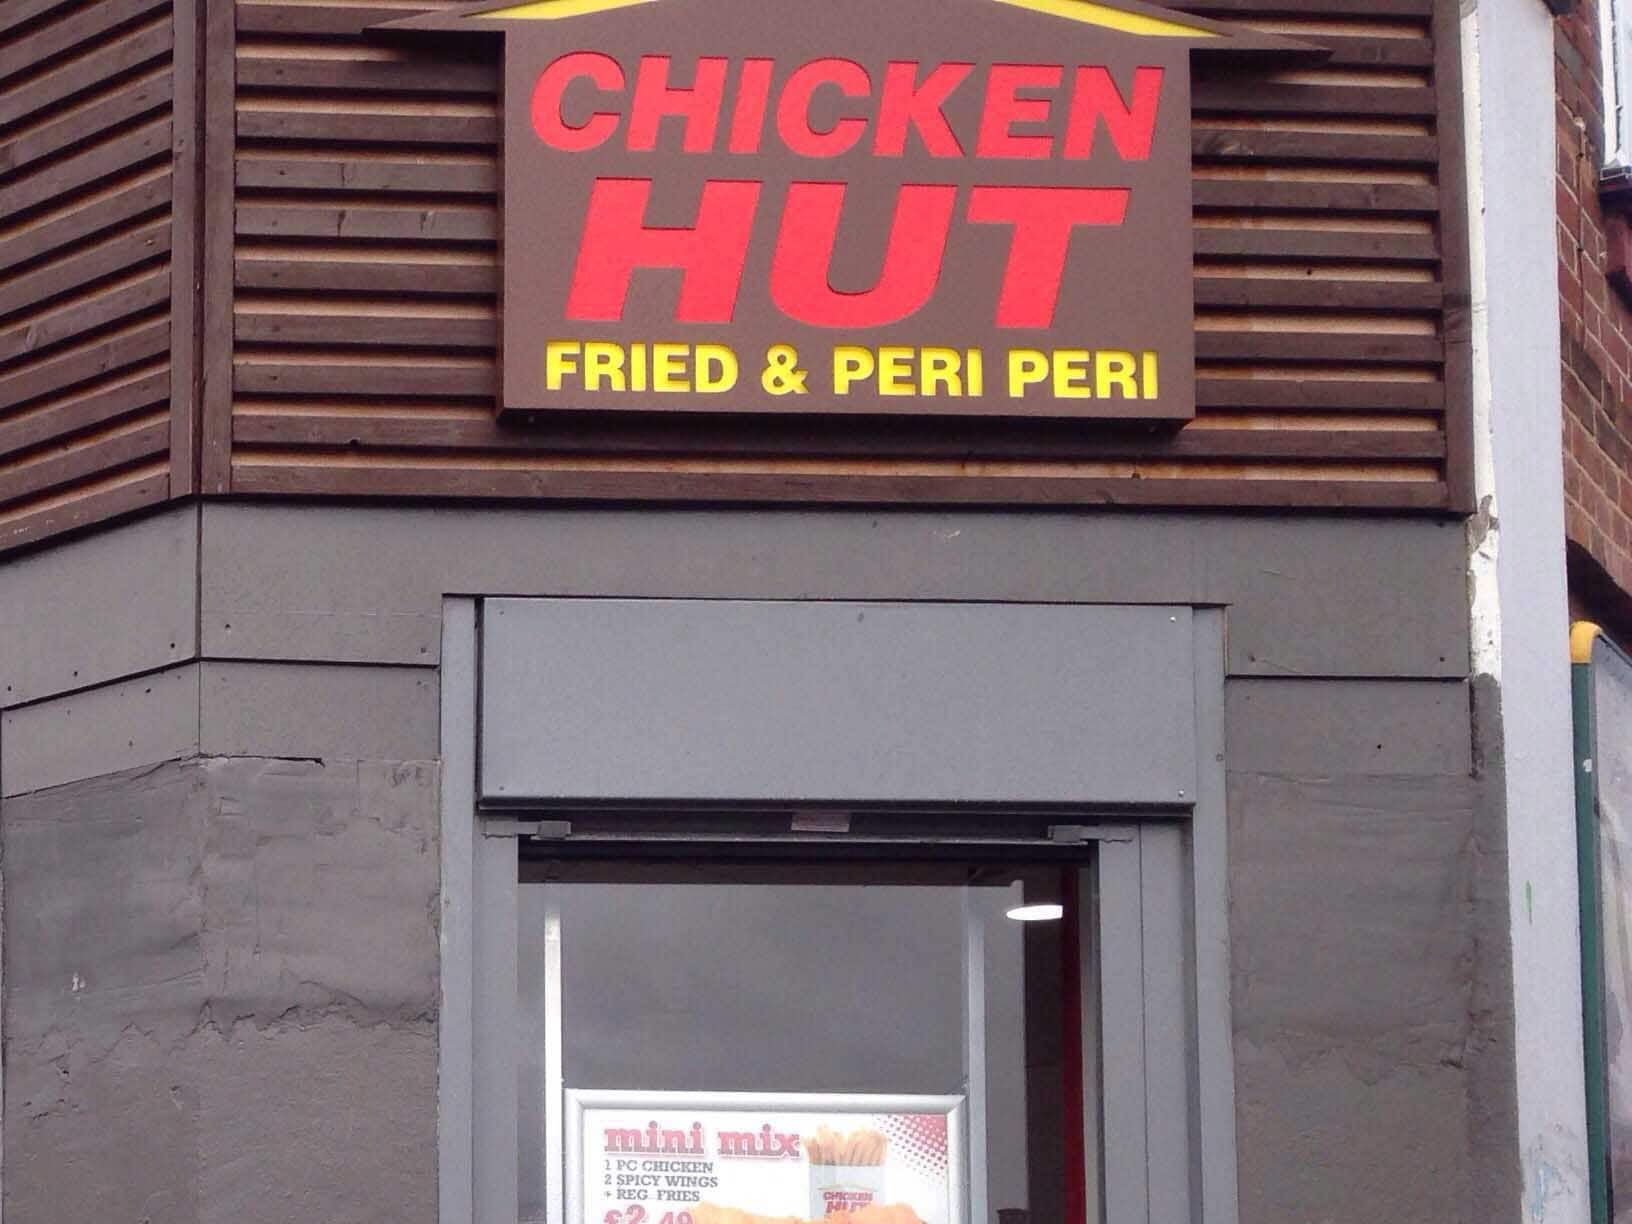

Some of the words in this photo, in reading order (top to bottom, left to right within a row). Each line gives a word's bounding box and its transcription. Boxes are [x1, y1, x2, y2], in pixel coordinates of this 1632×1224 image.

[530, 50, 1166, 163] CHICKEN
[564, 175, 1132, 330] HUT
[543, 341, 740, 396] FRIED
[762, 342, 810, 395] &
[833, 346, 985, 398] PERI
[1008, 349, 1159, 400] PERI
[604, 1120, 705, 1155] mini
[718, 1123, 801, 1158] mix
[604, 1173, 613, 1185] 2
[616, 1174, 661, 1187] SPICY
[664, 1175, 719, 1188] WINGS
[616, 1159, 638, 1172] PC
[641, 1160, 714, 1174] CHICKEN
[656, 1189, 701, 1202] FRIES
